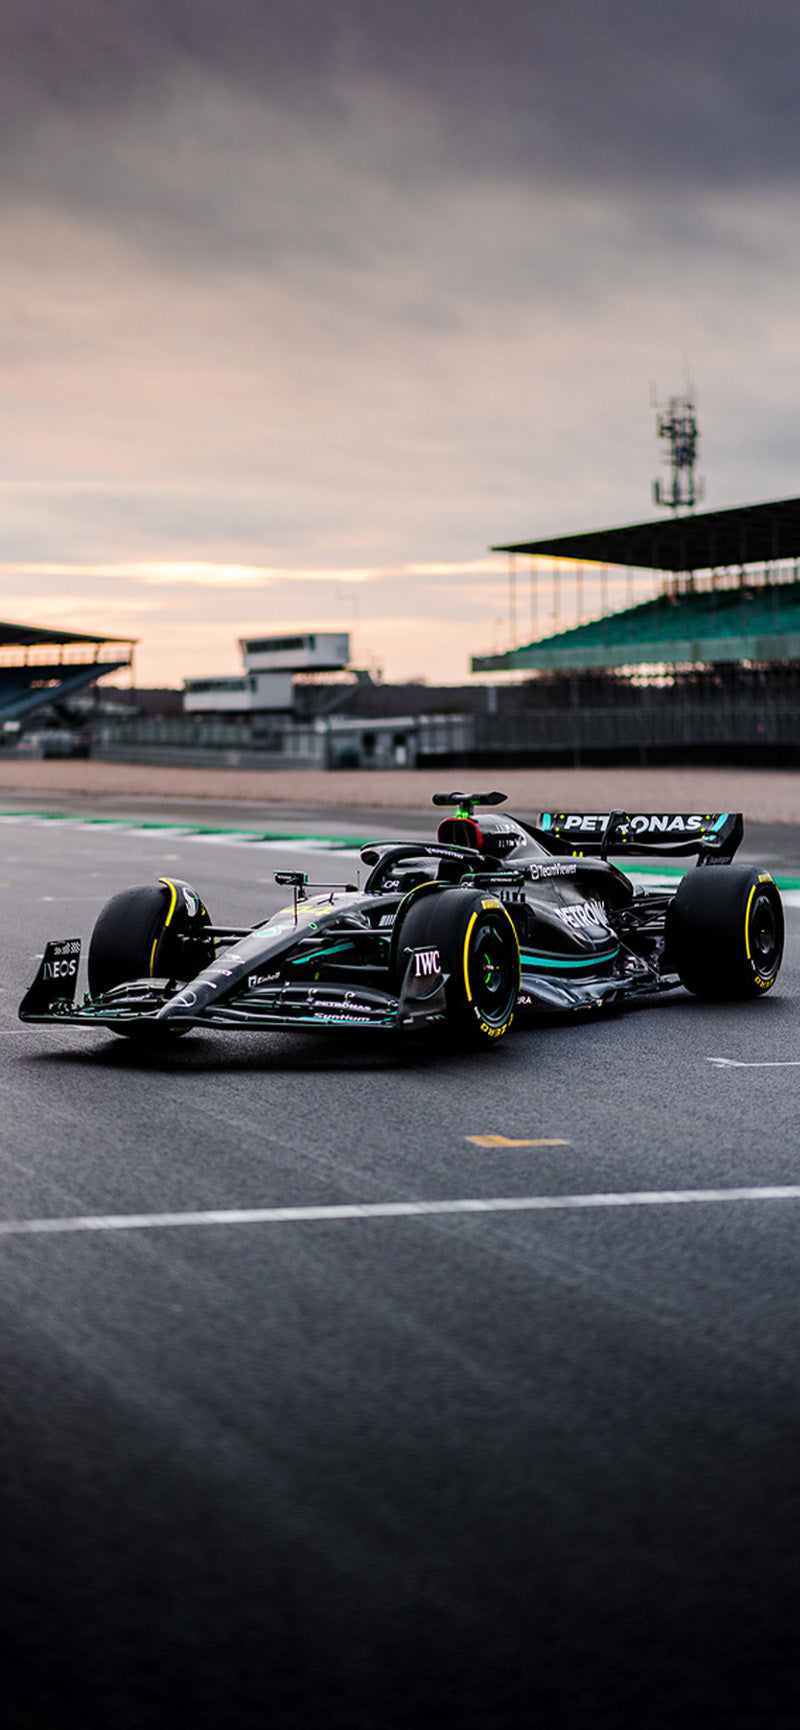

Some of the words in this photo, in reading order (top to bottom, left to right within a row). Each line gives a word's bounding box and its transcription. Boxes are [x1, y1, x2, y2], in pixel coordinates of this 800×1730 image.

[538, 863, 577, 877] TeamViewer
[43, 959, 77, 980] INEOS
[414, 950, 441, 977] IWC
[313, 1012, 370, 1022] Syntium
